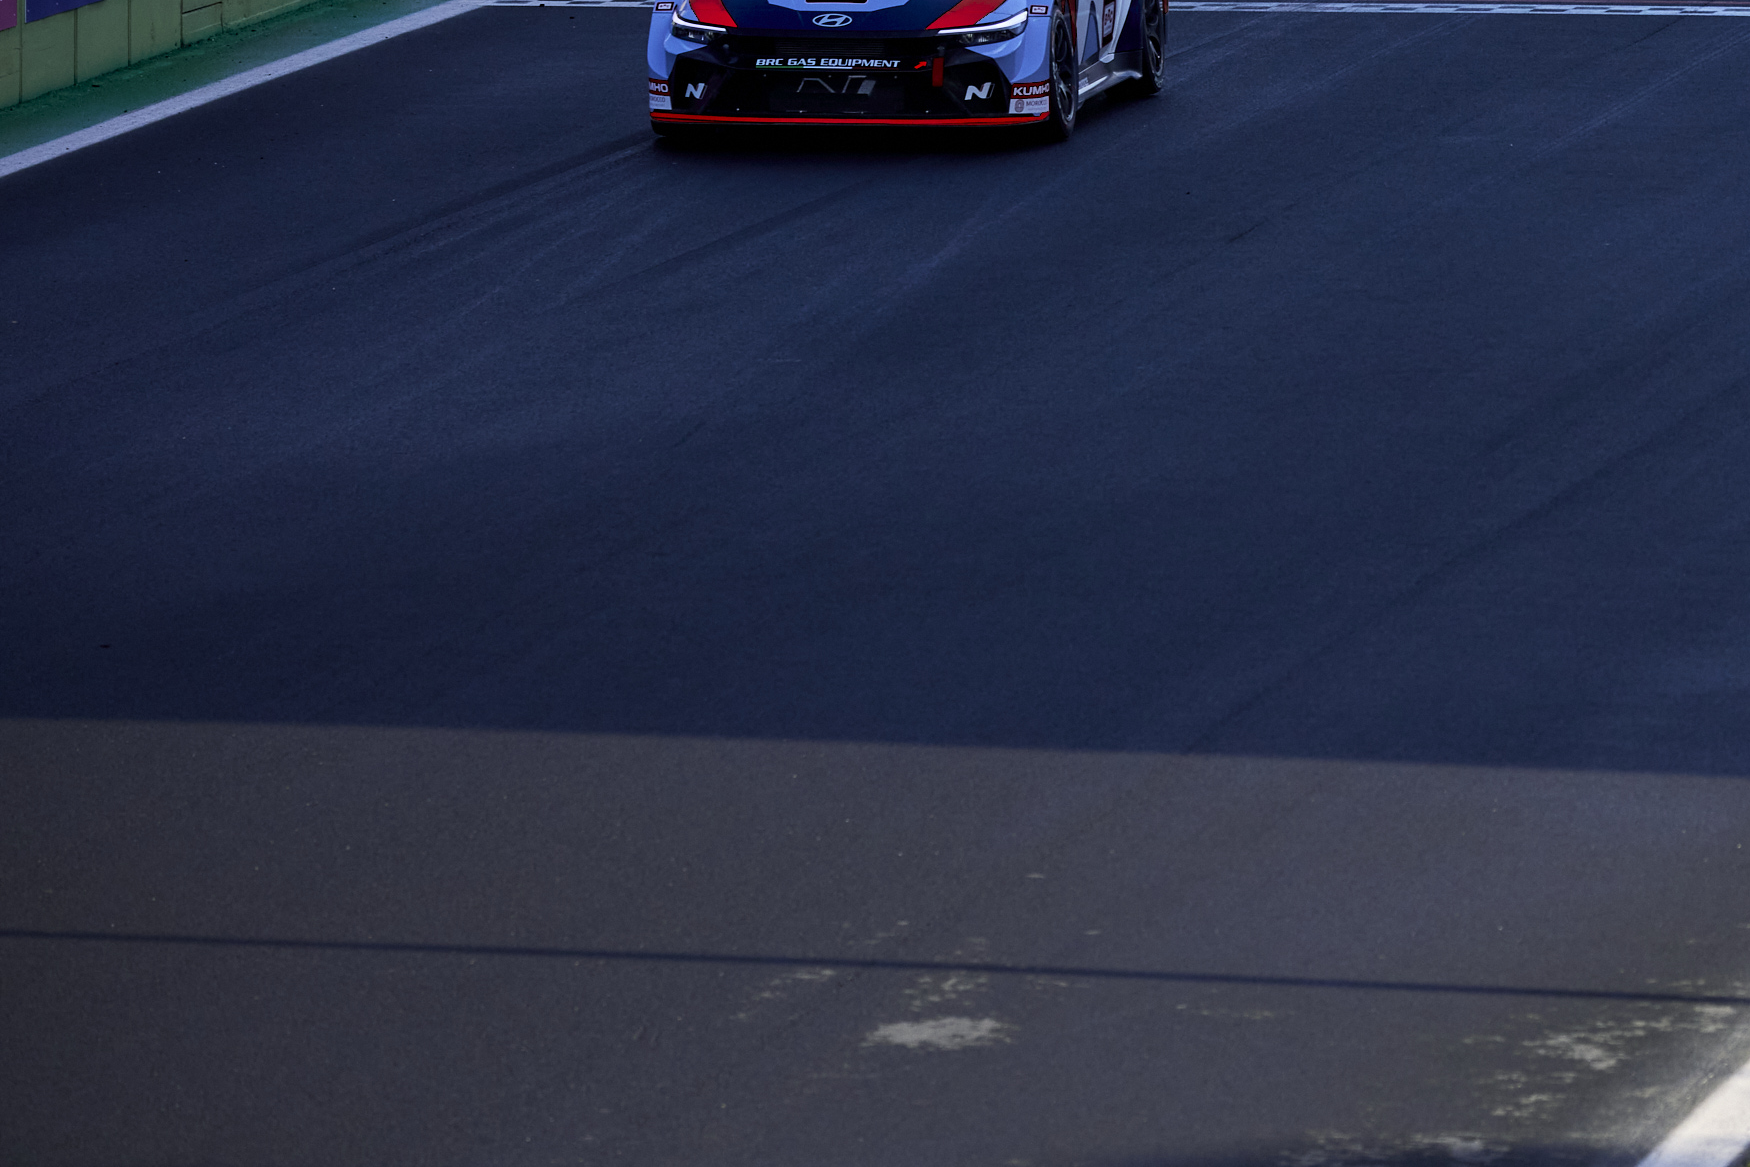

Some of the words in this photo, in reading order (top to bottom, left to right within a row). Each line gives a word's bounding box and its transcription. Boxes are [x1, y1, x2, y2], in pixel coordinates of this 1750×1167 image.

[755, 58, 784, 67] BRC
[787, 58, 817, 67] GAS
[820, 58, 901, 68] EQUIPMENT
